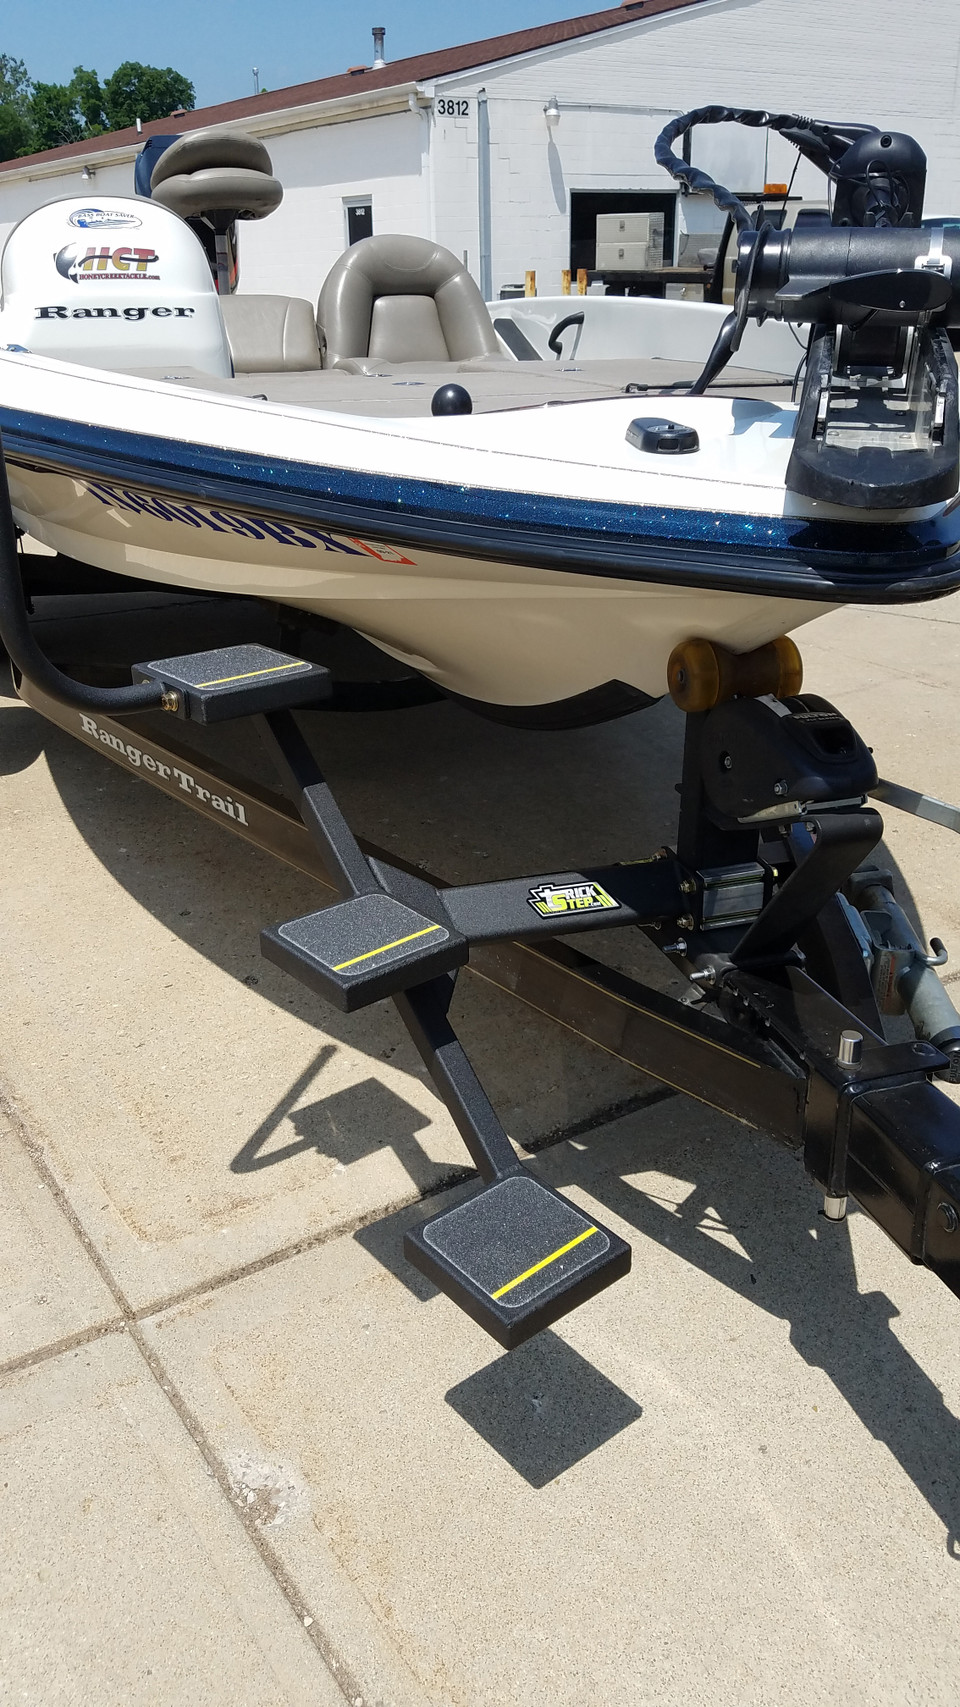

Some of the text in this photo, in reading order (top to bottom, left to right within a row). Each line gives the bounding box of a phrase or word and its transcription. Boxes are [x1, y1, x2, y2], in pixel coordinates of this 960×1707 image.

[437, 99, 469, 116] 3812
[83, 247, 155, 271] HCT
[34, 306, 195, 321] Ranger
[79, 713, 249, 827] Ranger Trail
